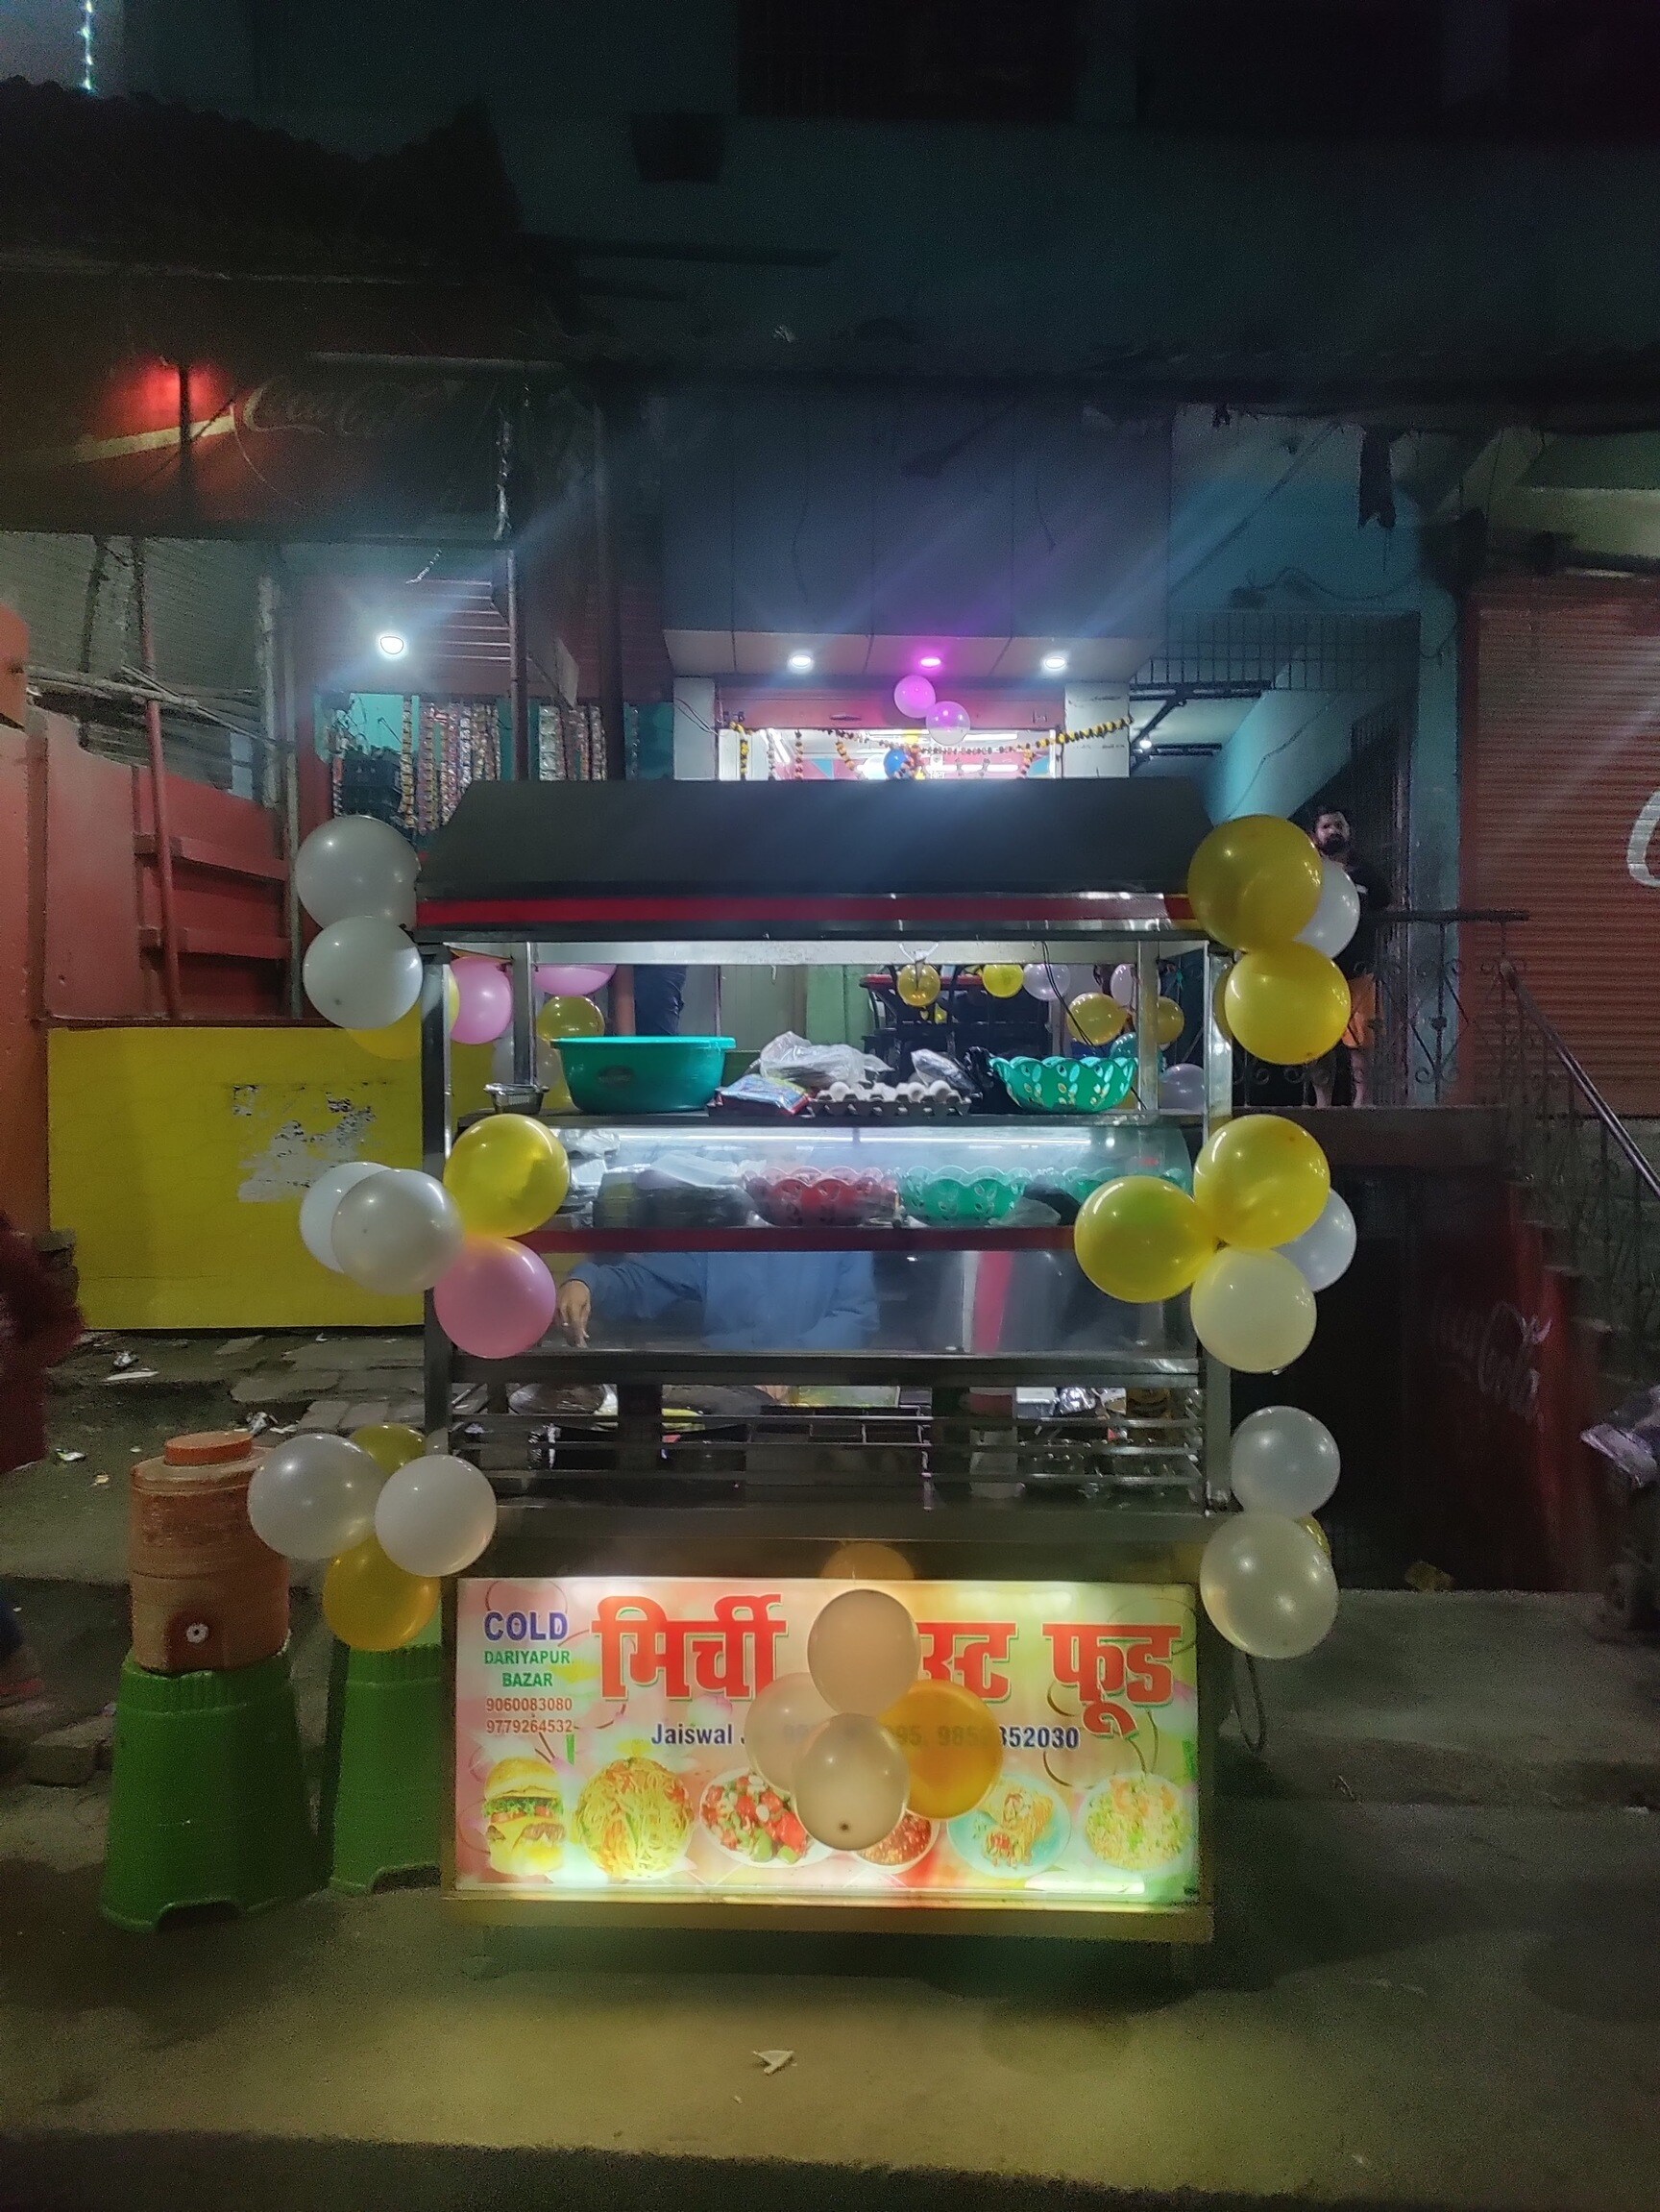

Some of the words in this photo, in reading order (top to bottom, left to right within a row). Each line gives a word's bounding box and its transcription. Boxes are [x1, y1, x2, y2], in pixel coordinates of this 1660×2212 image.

[484, 1611, 568, 1640] COLD
[484, 1651, 570, 1664] DARIYAPUR
[592, 1594, 788, 1699] मिर्ची
[1042, 1624, 1182, 1735] फूड
[502, 1673, 552, 1686] BAZAR
[486, 1698, 573, 1711] 9060083080
[651, 1723, 733, 1745] Jaiswal
